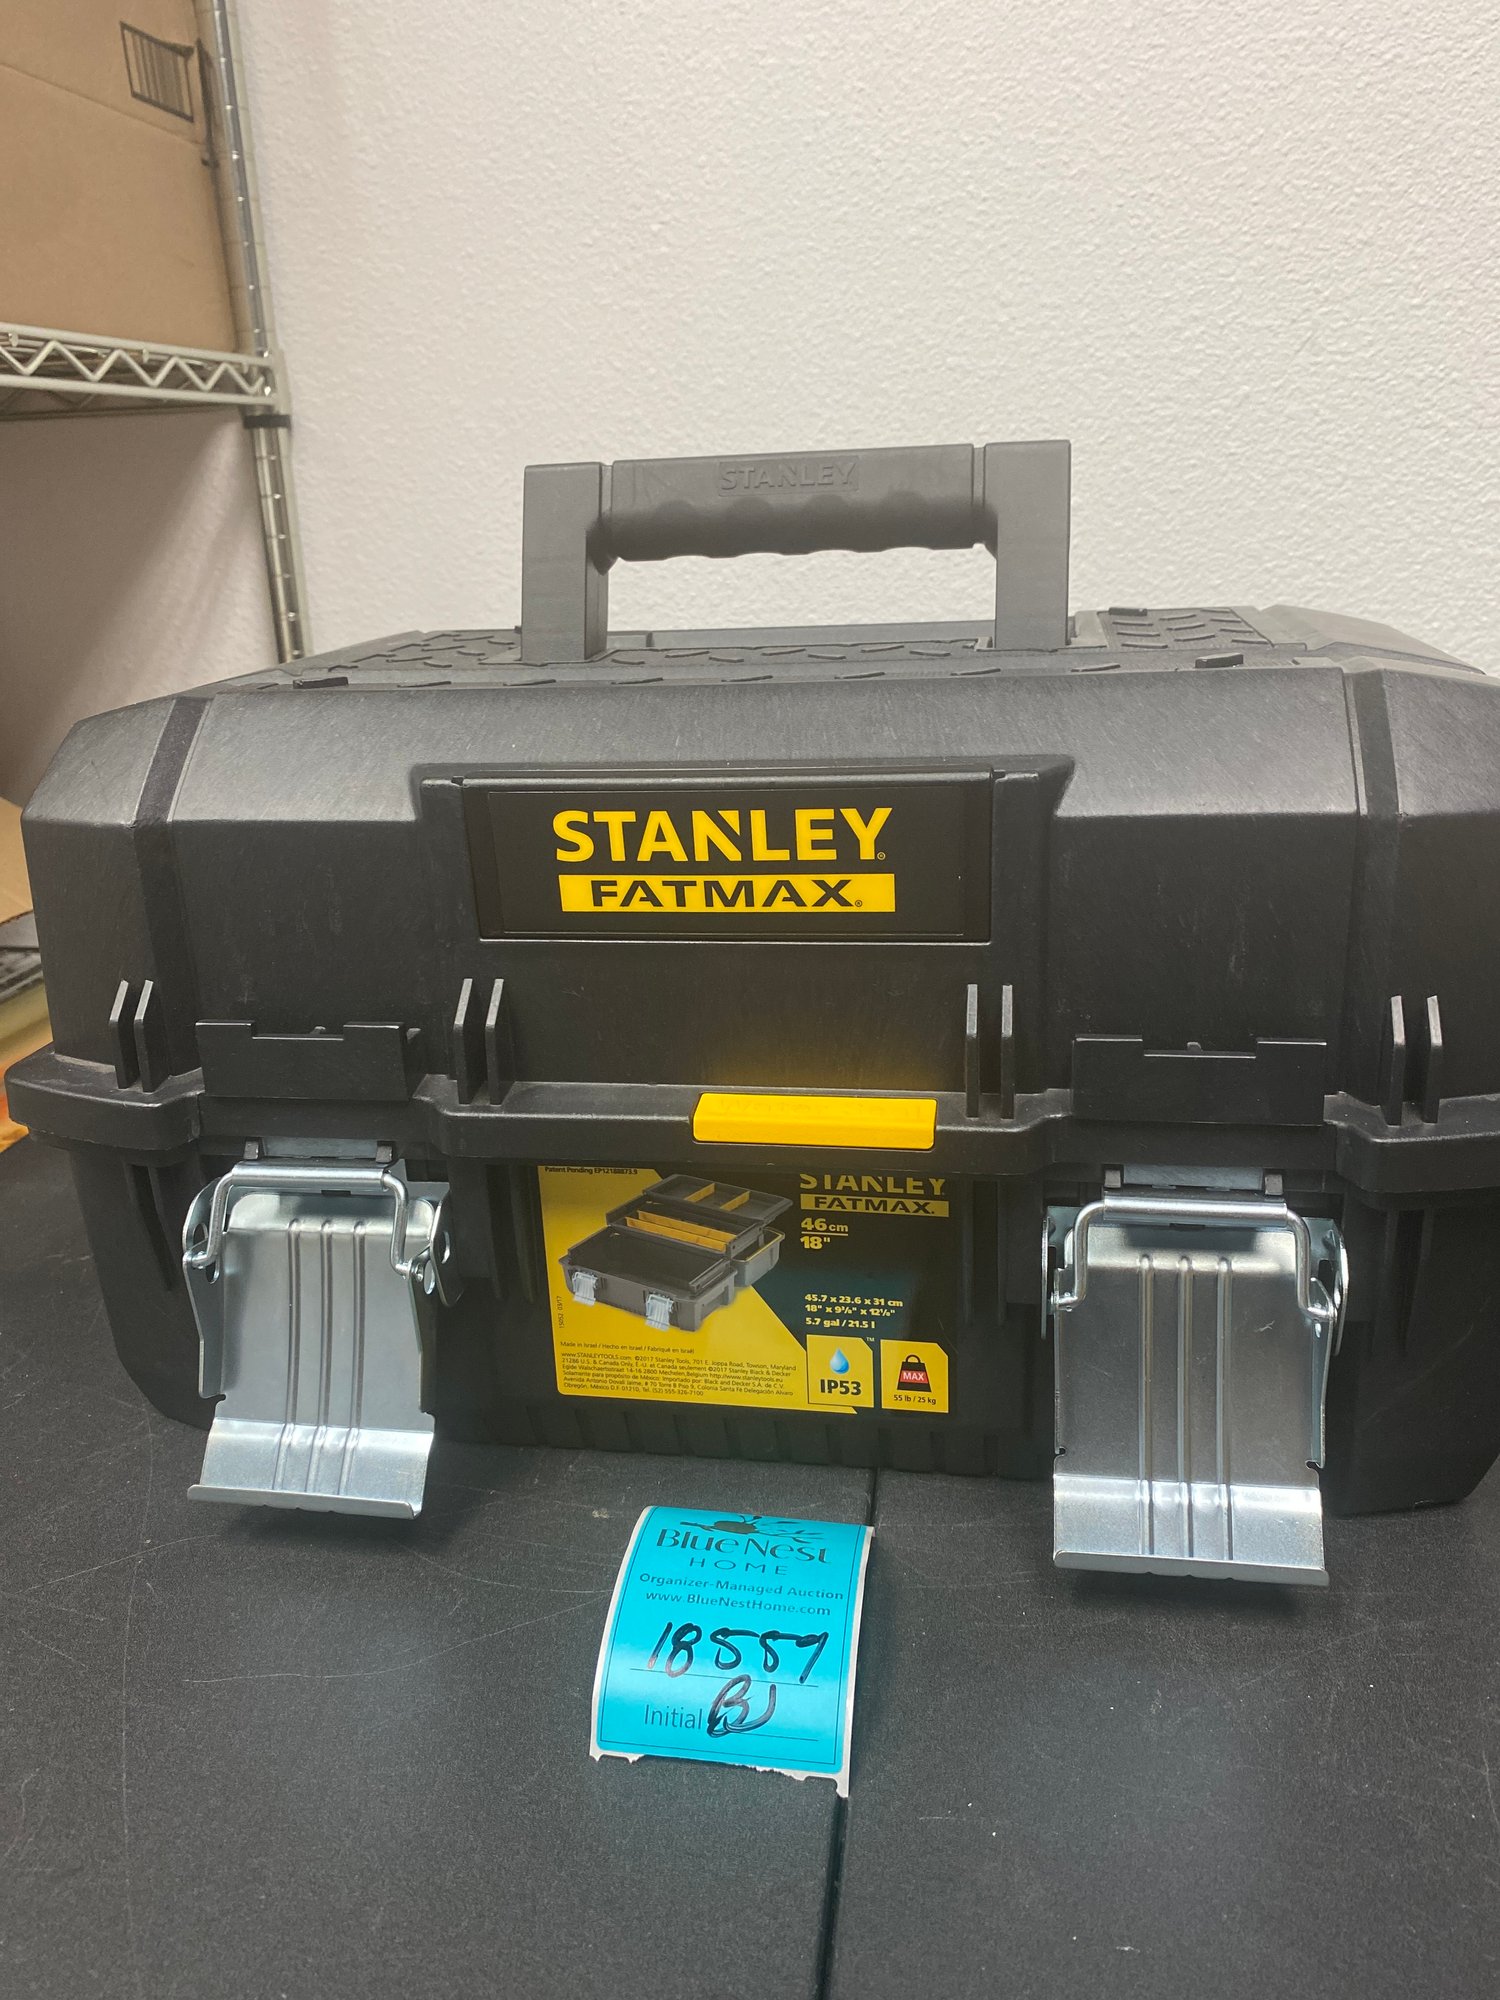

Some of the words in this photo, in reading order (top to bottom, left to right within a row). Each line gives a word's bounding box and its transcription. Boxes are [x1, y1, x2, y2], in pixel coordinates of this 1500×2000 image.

[721, 462, 856, 490] STANLEY
[552, 808, 892, 862] STANLEY
[590, 879, 852, 908] FATMAX
[815, 1196, 931, 1214] FATMAX
[801, 1217, 827, 1231] 46
[829, 1224, 848, 1232] cm
[800, 1236, 830, 1249] 18"
[805, 1293, 827, 1302] 45.7
[839, 1295, 861, 1304] 23.6
[805, 1317, 821, 1325] 5.7
[823, 1319, 840, 1327] gal
[848, 1320, 868, 1328] 21.5
[770, 1364, 796, 1372] Maryland
[903, 1371, 924, 1381] MAX
[820, 1379, 861, 1395] IP53
[928, 1396, 936, 1405] kg
[690, 1557, 788, 1575] HOME
[640, 1573, 782, 1595] Organizer-Managed
[788, 1586, 843, 1600] Auction
[646, 1592, 831, 1616] www.BlueNestHome.com
[644, 1704, 702, 1730] Initial
